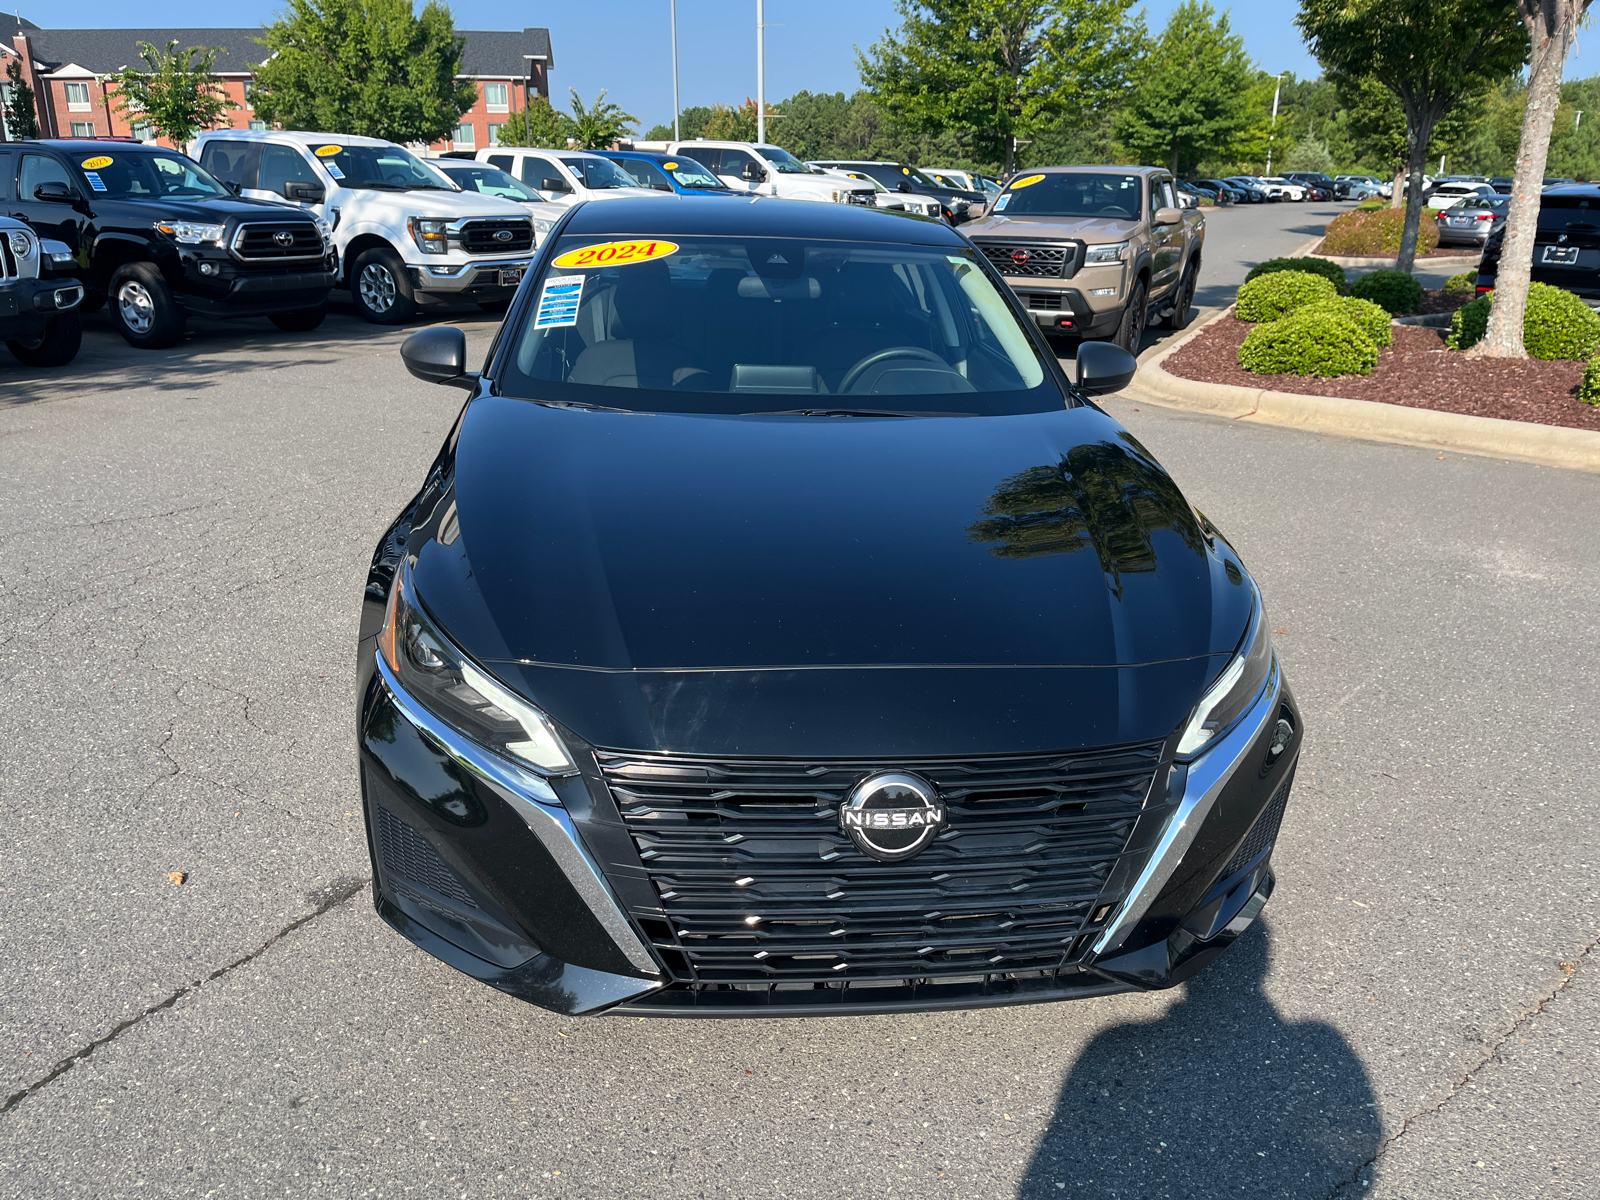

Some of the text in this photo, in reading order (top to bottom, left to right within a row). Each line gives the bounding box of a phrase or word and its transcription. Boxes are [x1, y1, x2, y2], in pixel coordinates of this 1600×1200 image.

[87, 157, 109, 168] 2023
[574, 242, 657, 265] 2024
[846, 809, 941, 826] NISSAN
